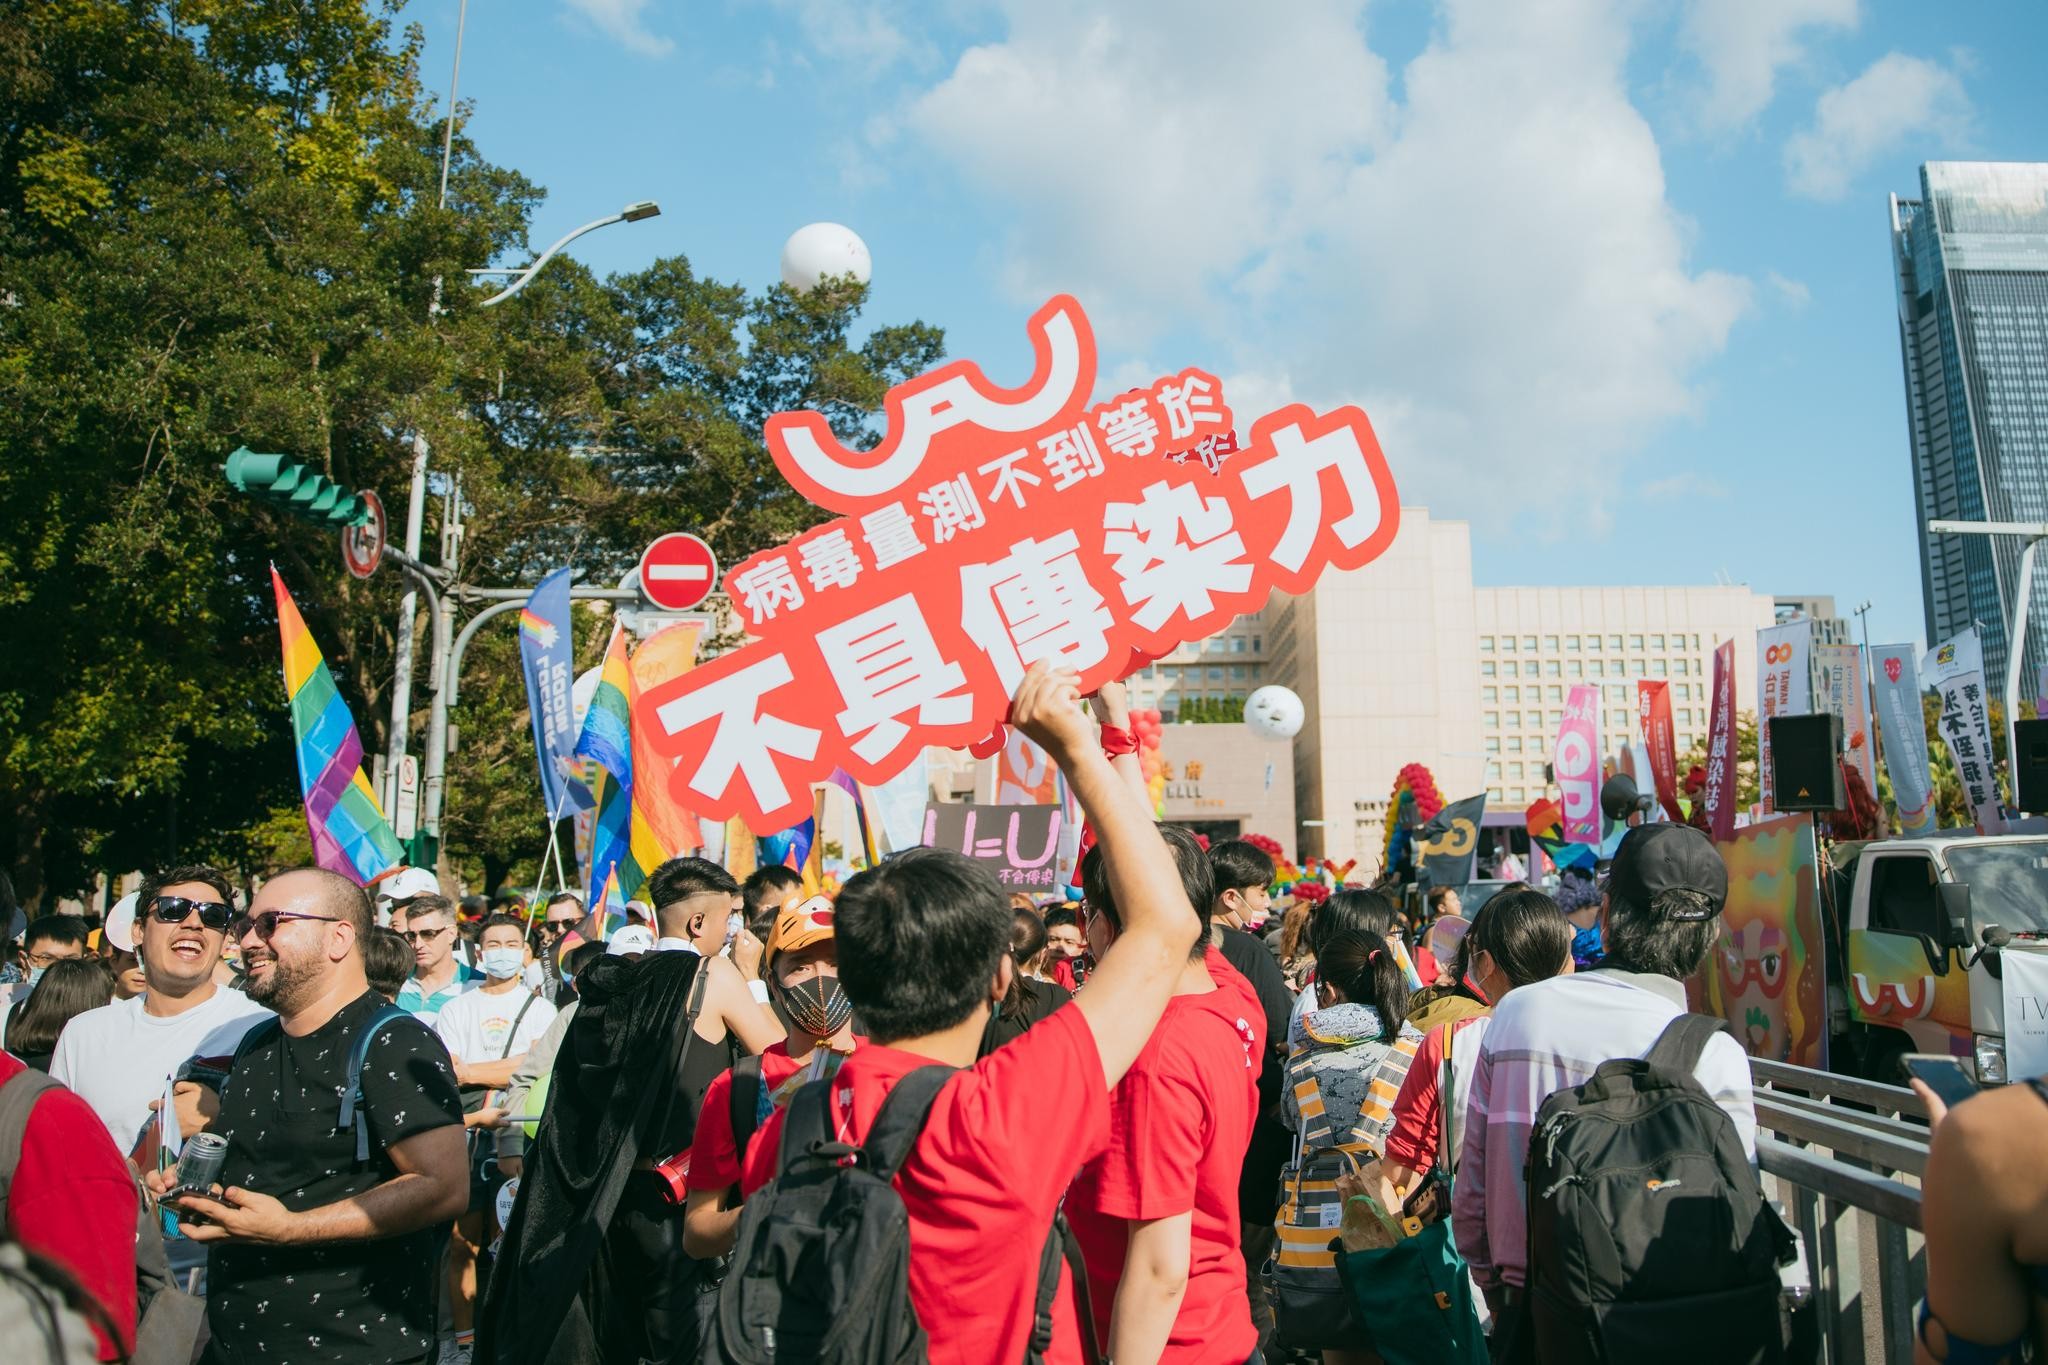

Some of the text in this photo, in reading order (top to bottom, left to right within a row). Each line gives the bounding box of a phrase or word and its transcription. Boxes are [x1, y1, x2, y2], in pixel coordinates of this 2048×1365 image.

[656, 423, 1381, 814] 不具傳染力
[735, 376, 1222, 625] 病毒量測不到等於
[1780, 669, 1791, 705] TAIWAN
